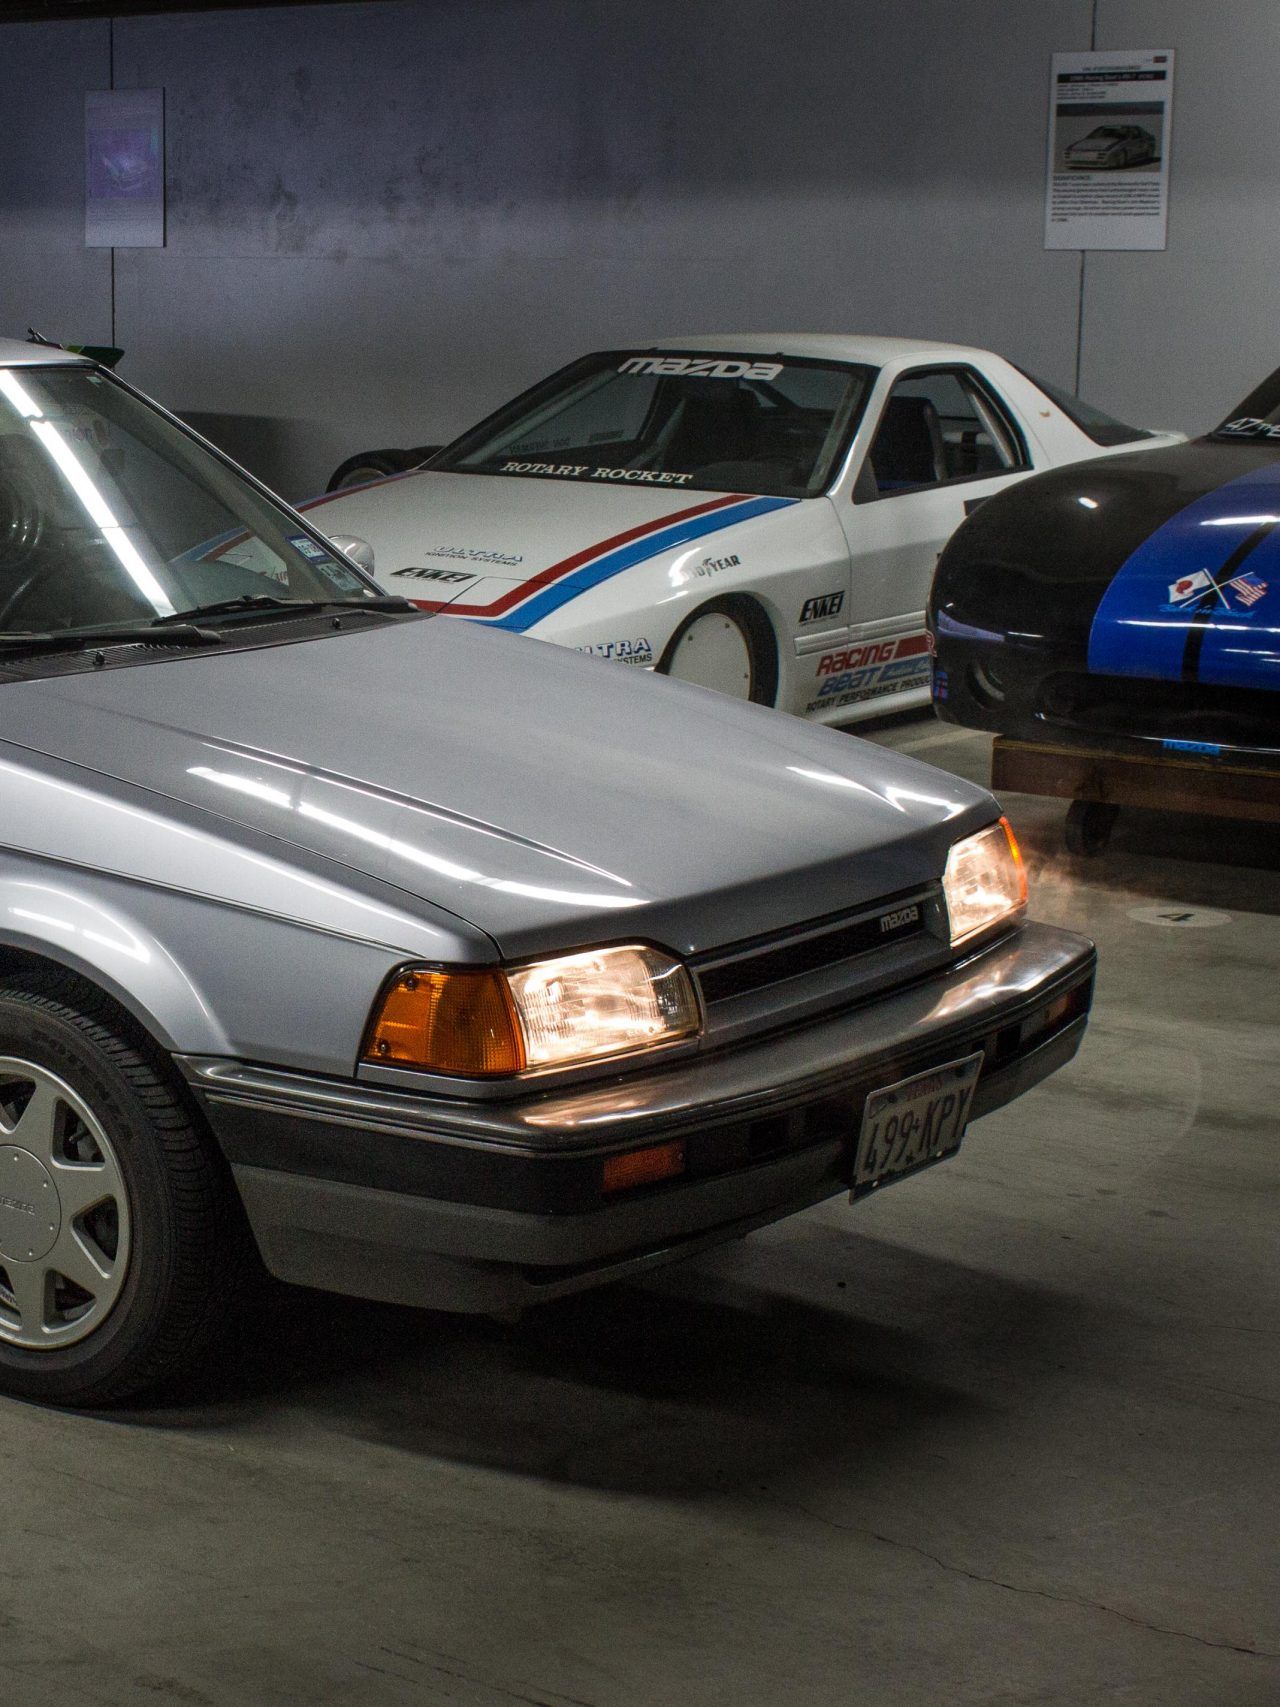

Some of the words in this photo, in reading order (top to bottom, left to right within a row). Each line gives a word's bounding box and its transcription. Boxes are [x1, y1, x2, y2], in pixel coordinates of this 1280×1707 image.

[617, 357, 784, 380] mazda
[499, 461, 588, 476] ROTARY
[591, 467, 693, 484] ROCKET
[391, 567, 477, 582] ENKEI
[799, 591, 845, 622] ENKEI
[577, 638, 652, 658] TRA
[815, 641, 896, 677] RACING
[817, 666, 883, 697] BEAT
[840, 684, 897, 703] PERFORMANCE
[881, 905, 919, 932] mazda
